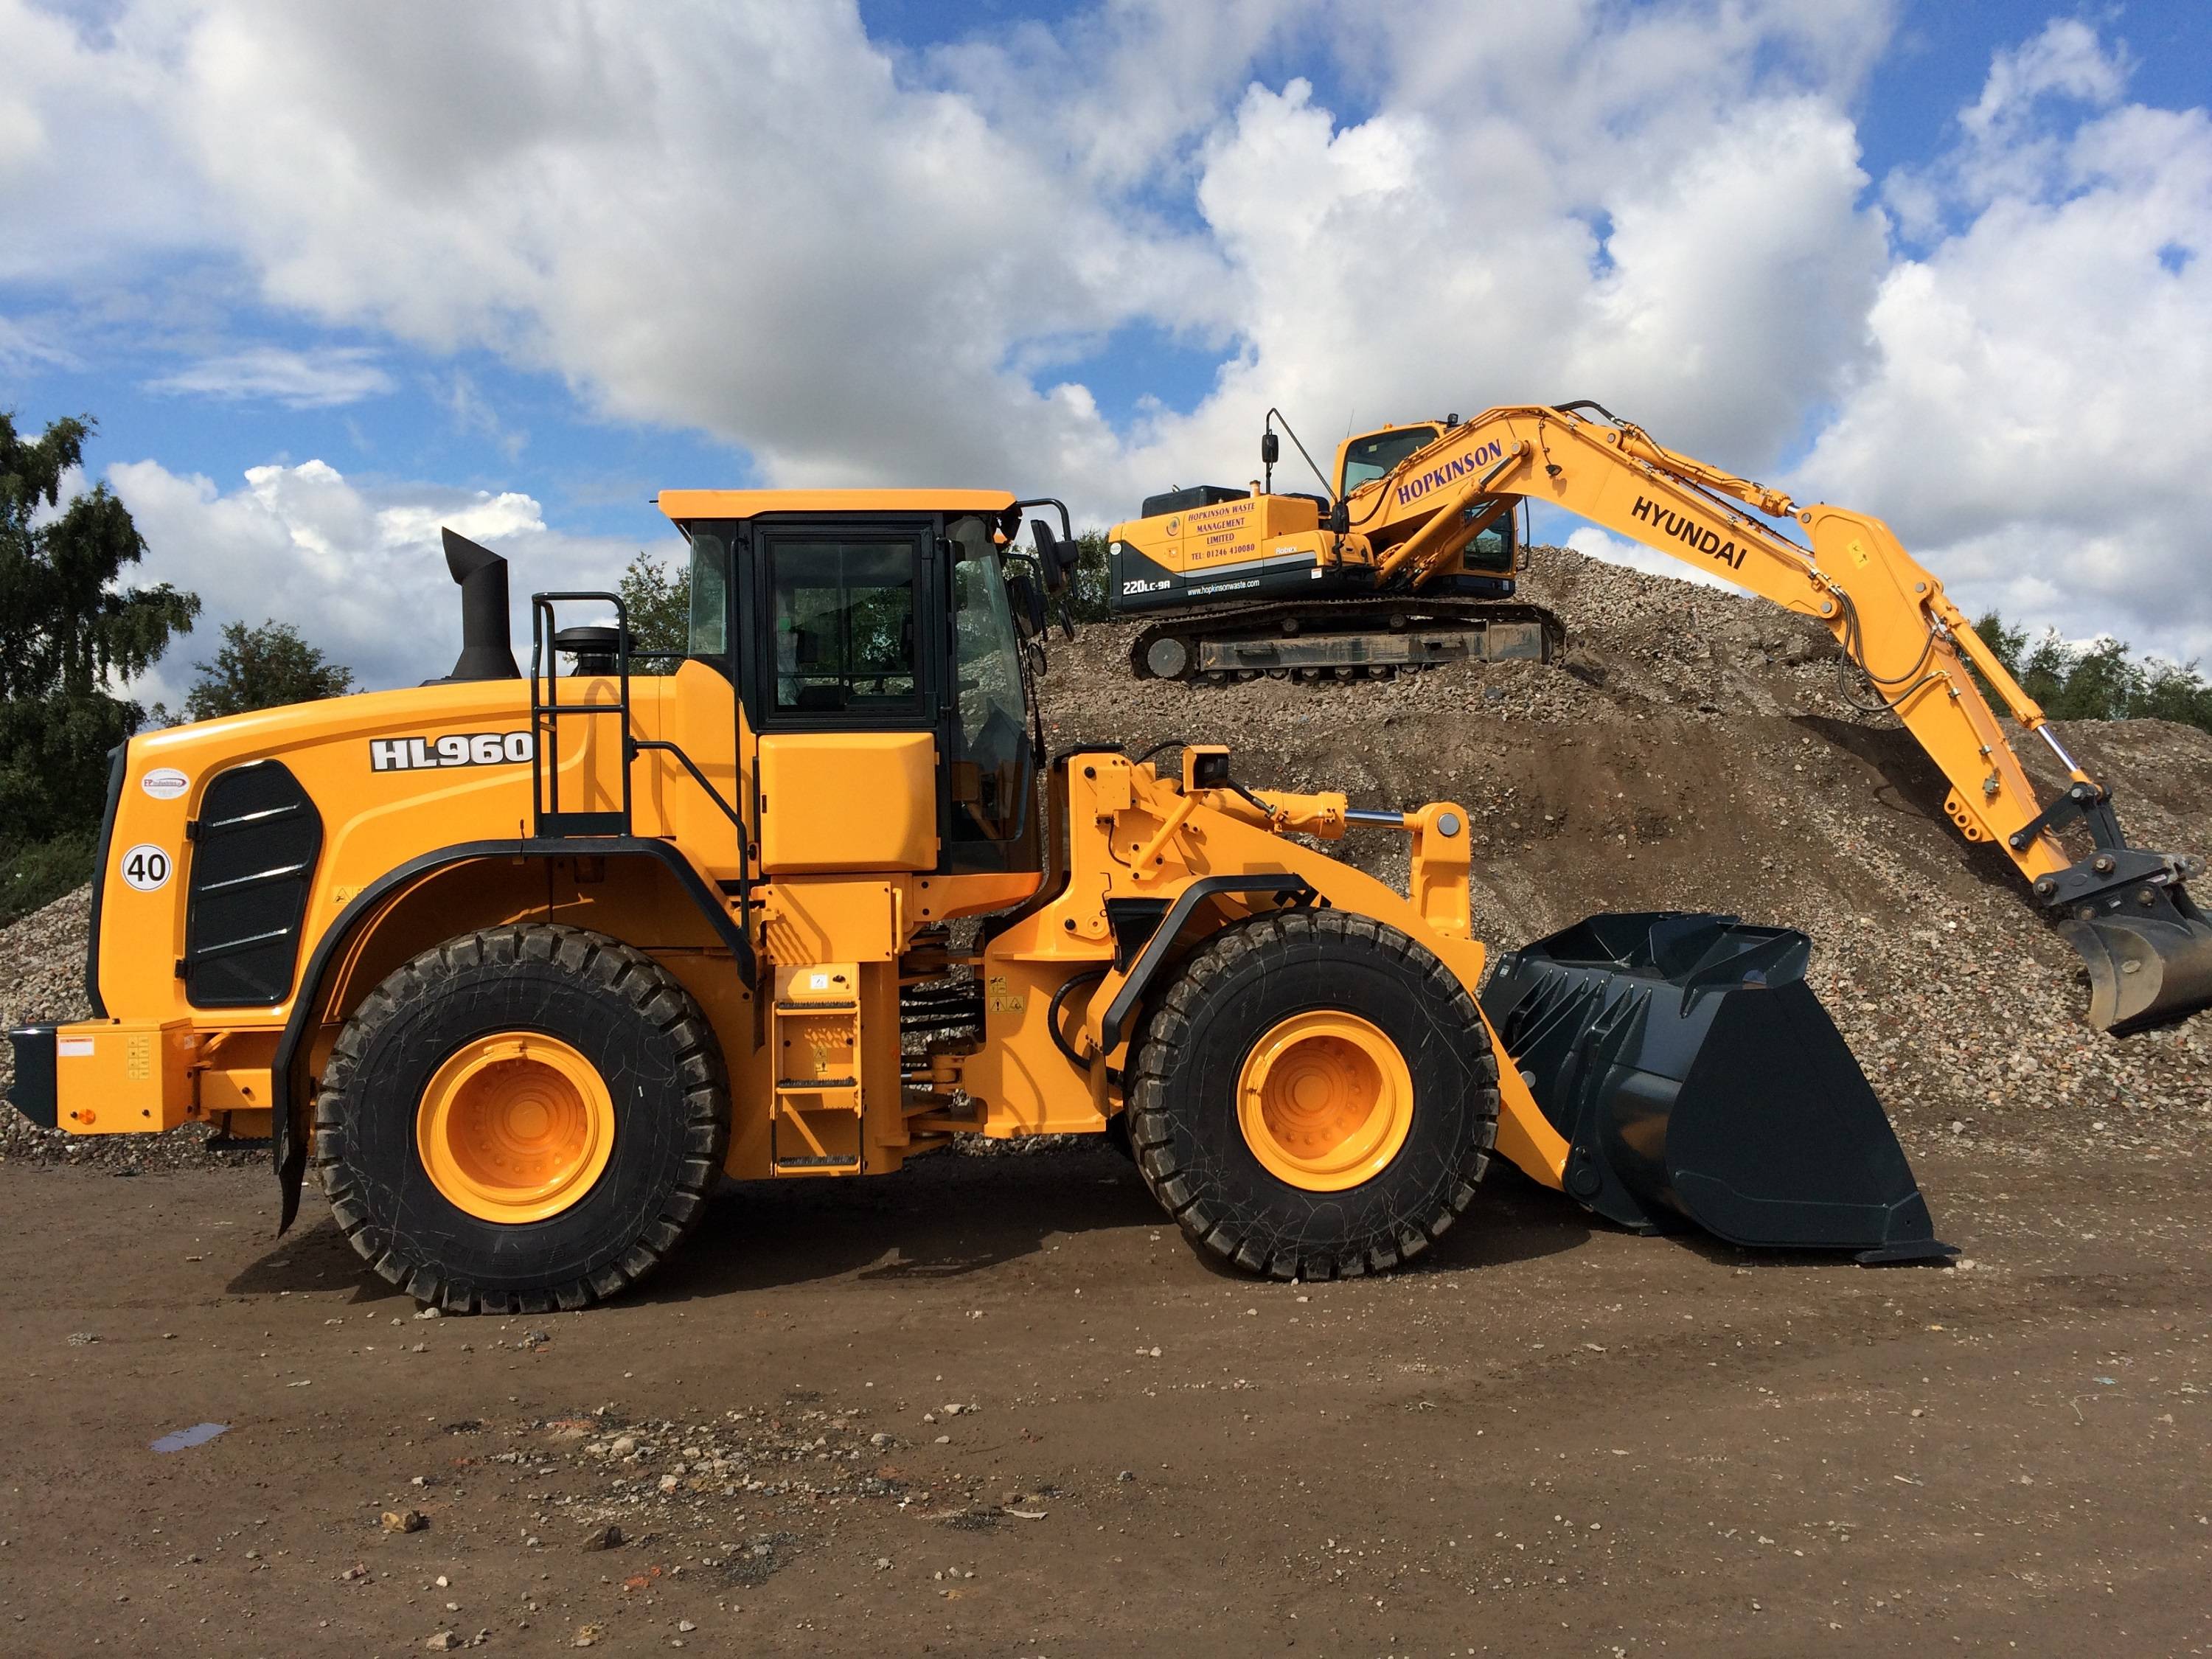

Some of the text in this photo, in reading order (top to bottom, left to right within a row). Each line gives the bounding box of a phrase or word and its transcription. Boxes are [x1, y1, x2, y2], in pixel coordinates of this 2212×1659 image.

[1397, 439, 1502, 505] HOPKINSON
[1188, 502, 1256, 521] HOPKINSON WASTE
[1197, 518, 1245, 532] MANAGEMENT
[1631, 495, 1747, 570] HYUNDAI
[1206, 533, 1234, 545] LIMITED
[1206, 549, 1228, 558] 01246
[1187, 579, 1260, 596] www.hopkinsonwaste.com
[371, 732, 533, 771] HL960
[127, 854, 166, 882] 40
